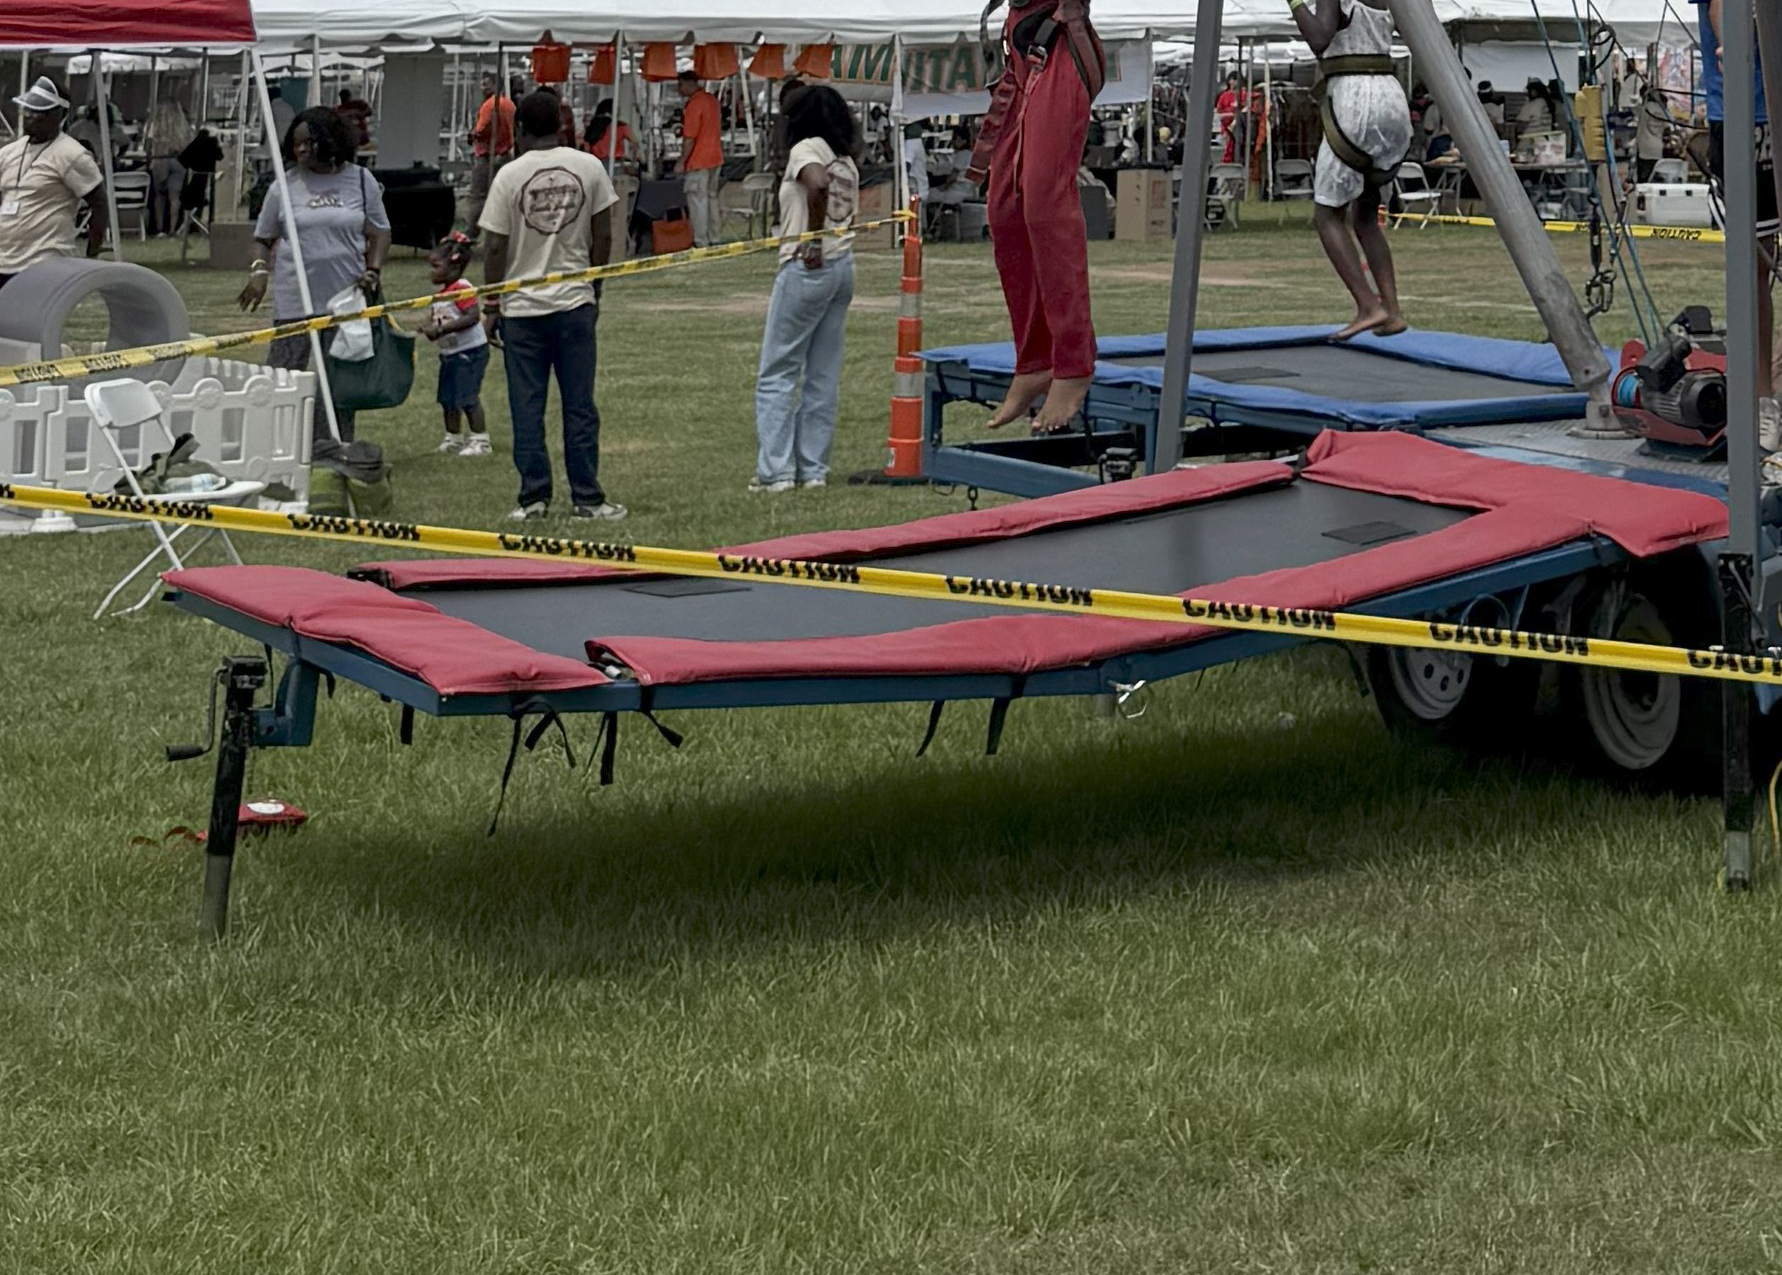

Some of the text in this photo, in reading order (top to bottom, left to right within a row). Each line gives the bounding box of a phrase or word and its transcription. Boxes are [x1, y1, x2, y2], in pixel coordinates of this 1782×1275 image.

[945, 574, 1094, 607] CAUTION
[1181, 598, 1336, 631] CAUTION
[1428, 622, 1590, 657] CAUTION
